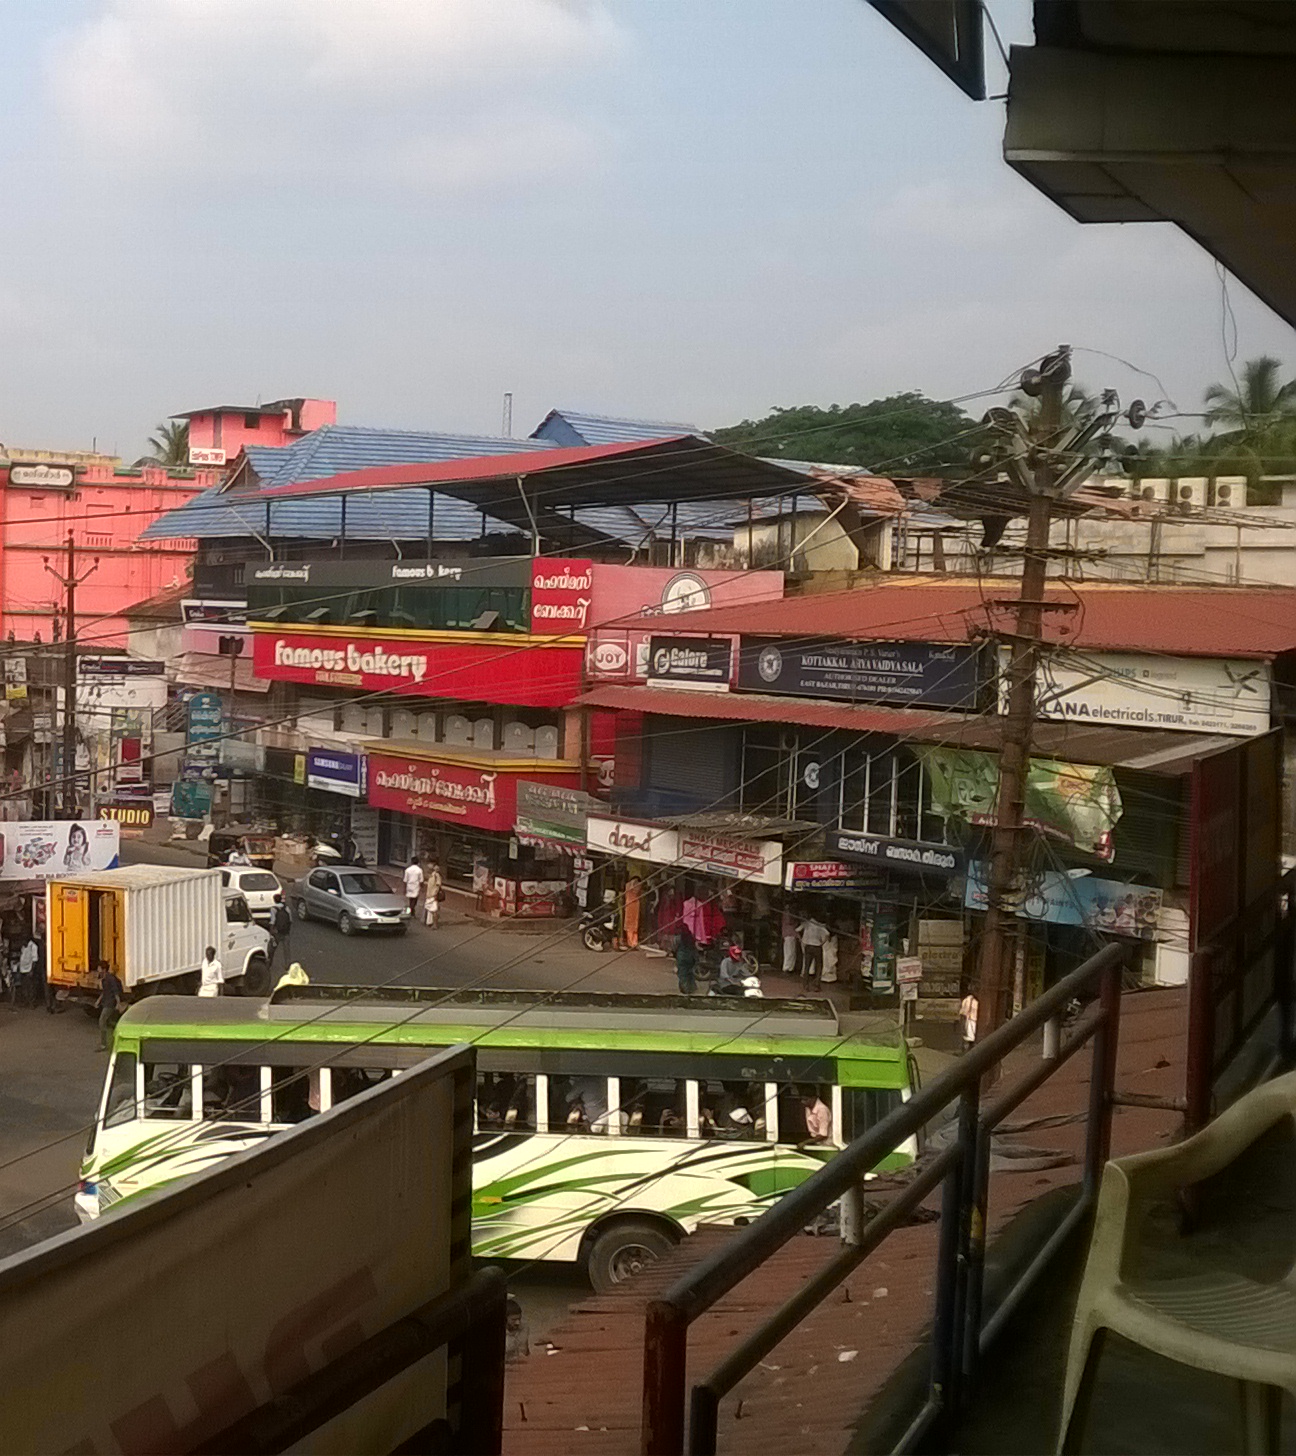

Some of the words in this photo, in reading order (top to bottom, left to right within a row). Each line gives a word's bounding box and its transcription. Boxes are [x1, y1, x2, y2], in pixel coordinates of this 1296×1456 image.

[391, 565, 426, 578] famous
[274, 639, 346, 671] famous
[346, 643, 428, 684] bakery
[596, 652, 622, 664] JOY
[670, 647, 709, 668] Galore
[800, 655, 849, 668] KOTTAKKAL
[871, 659, 902, 672] VAIDYA
[901, 661, 924, 673] SALA
[868, 675, 897, 685] DEALER
[99, 807, 151, 825] STUDIO
[716, 837, 761, 855] MEDICALS
